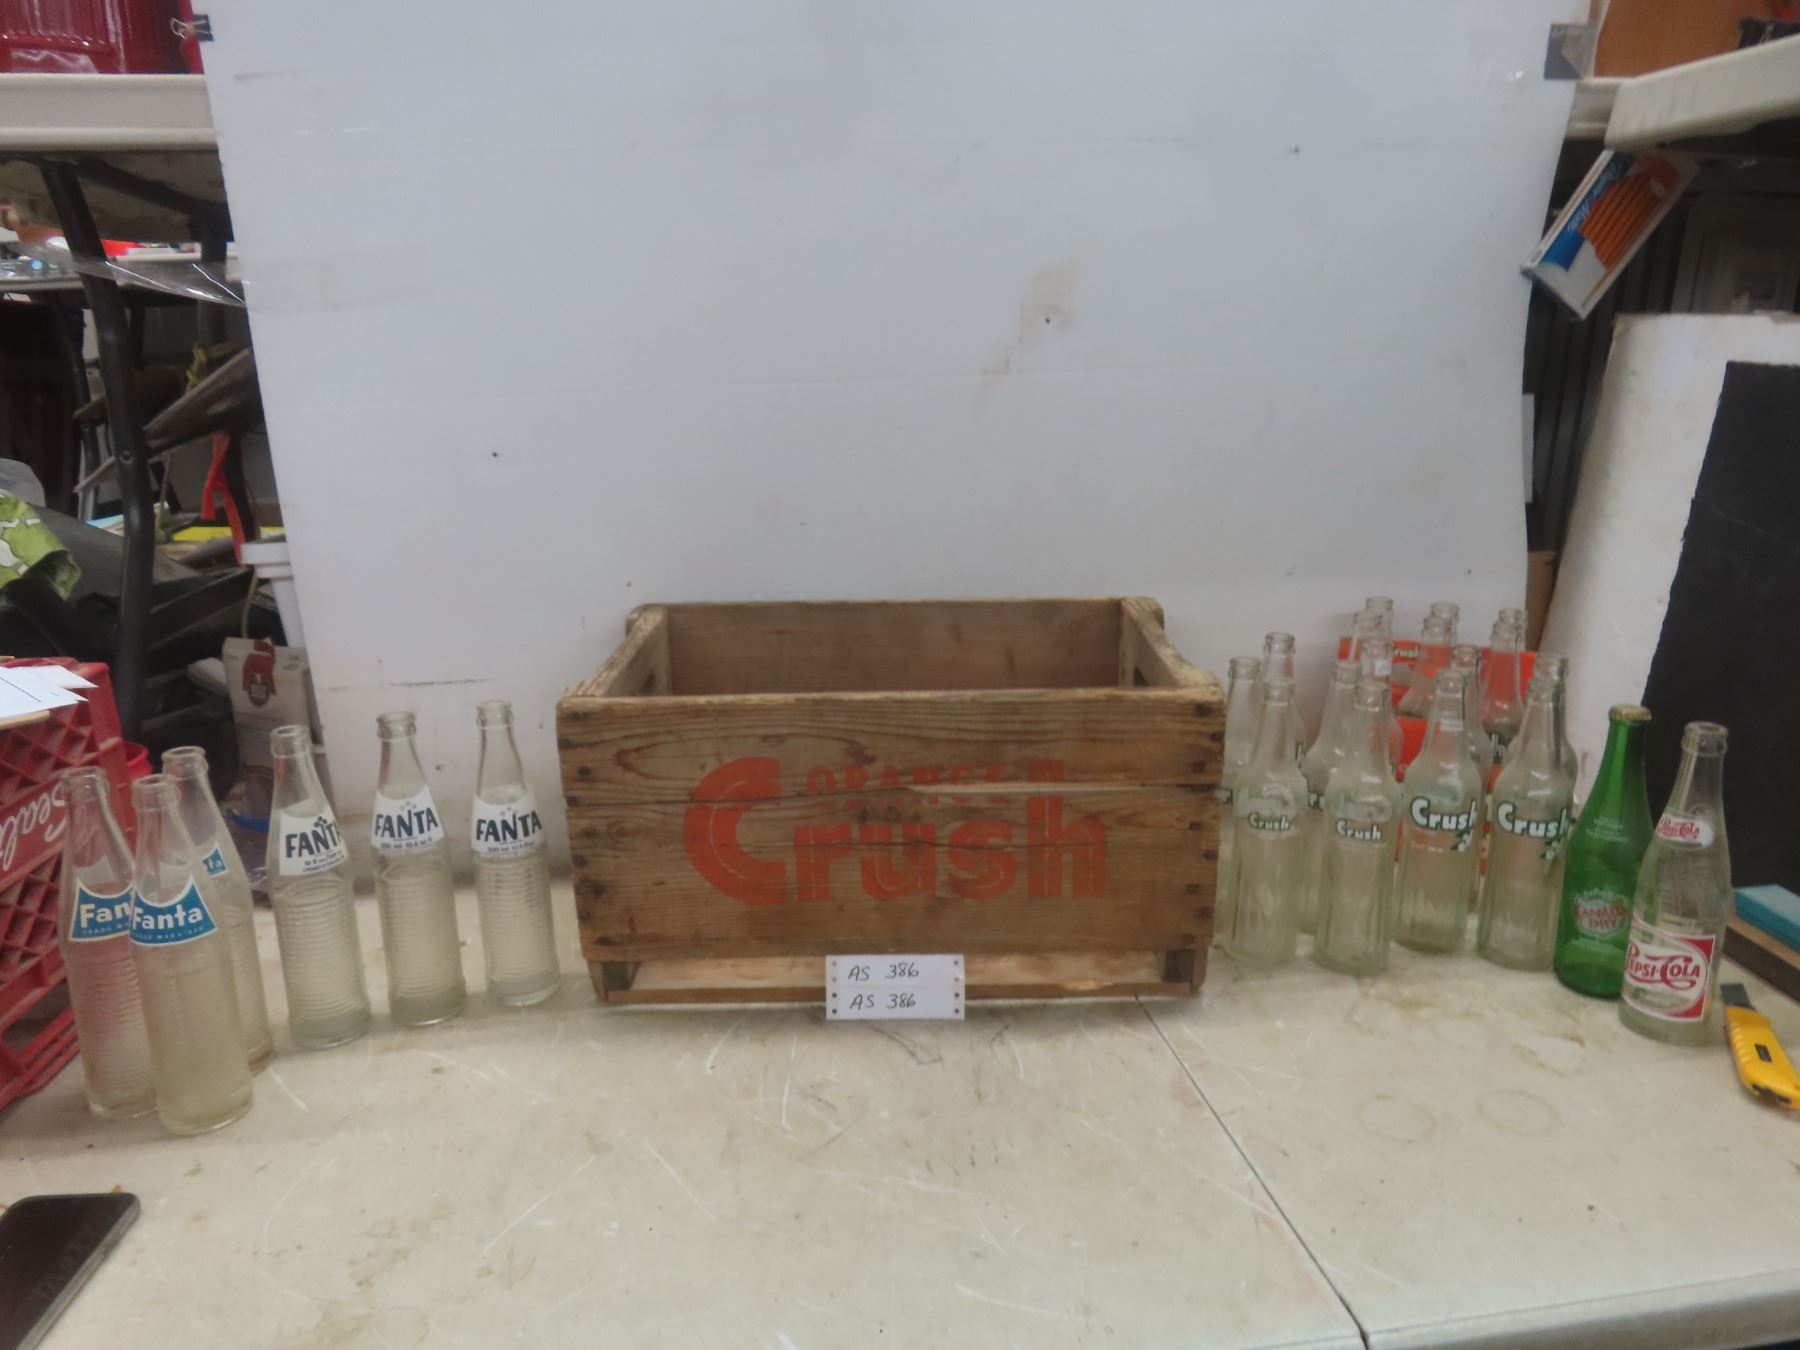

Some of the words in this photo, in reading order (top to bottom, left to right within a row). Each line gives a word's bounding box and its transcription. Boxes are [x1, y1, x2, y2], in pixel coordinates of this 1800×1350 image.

[375, 808, 438, 838] FANTA
[476, 811, 542, 841] FANTA
[683, 757, 1106, 905] Crush
[1249, 812, 1289, 831] Crush
[1336, 820, 1381, 840] Crush
[79, 899, 132, 929] Fan
[133, 904, 204, 931] Fanta
[848, 965, 870, 981] AS
[885, 962, 919, 979] 386
[849, 993, 874, 1010] AS
[886, 993, 916, 1009] 386
